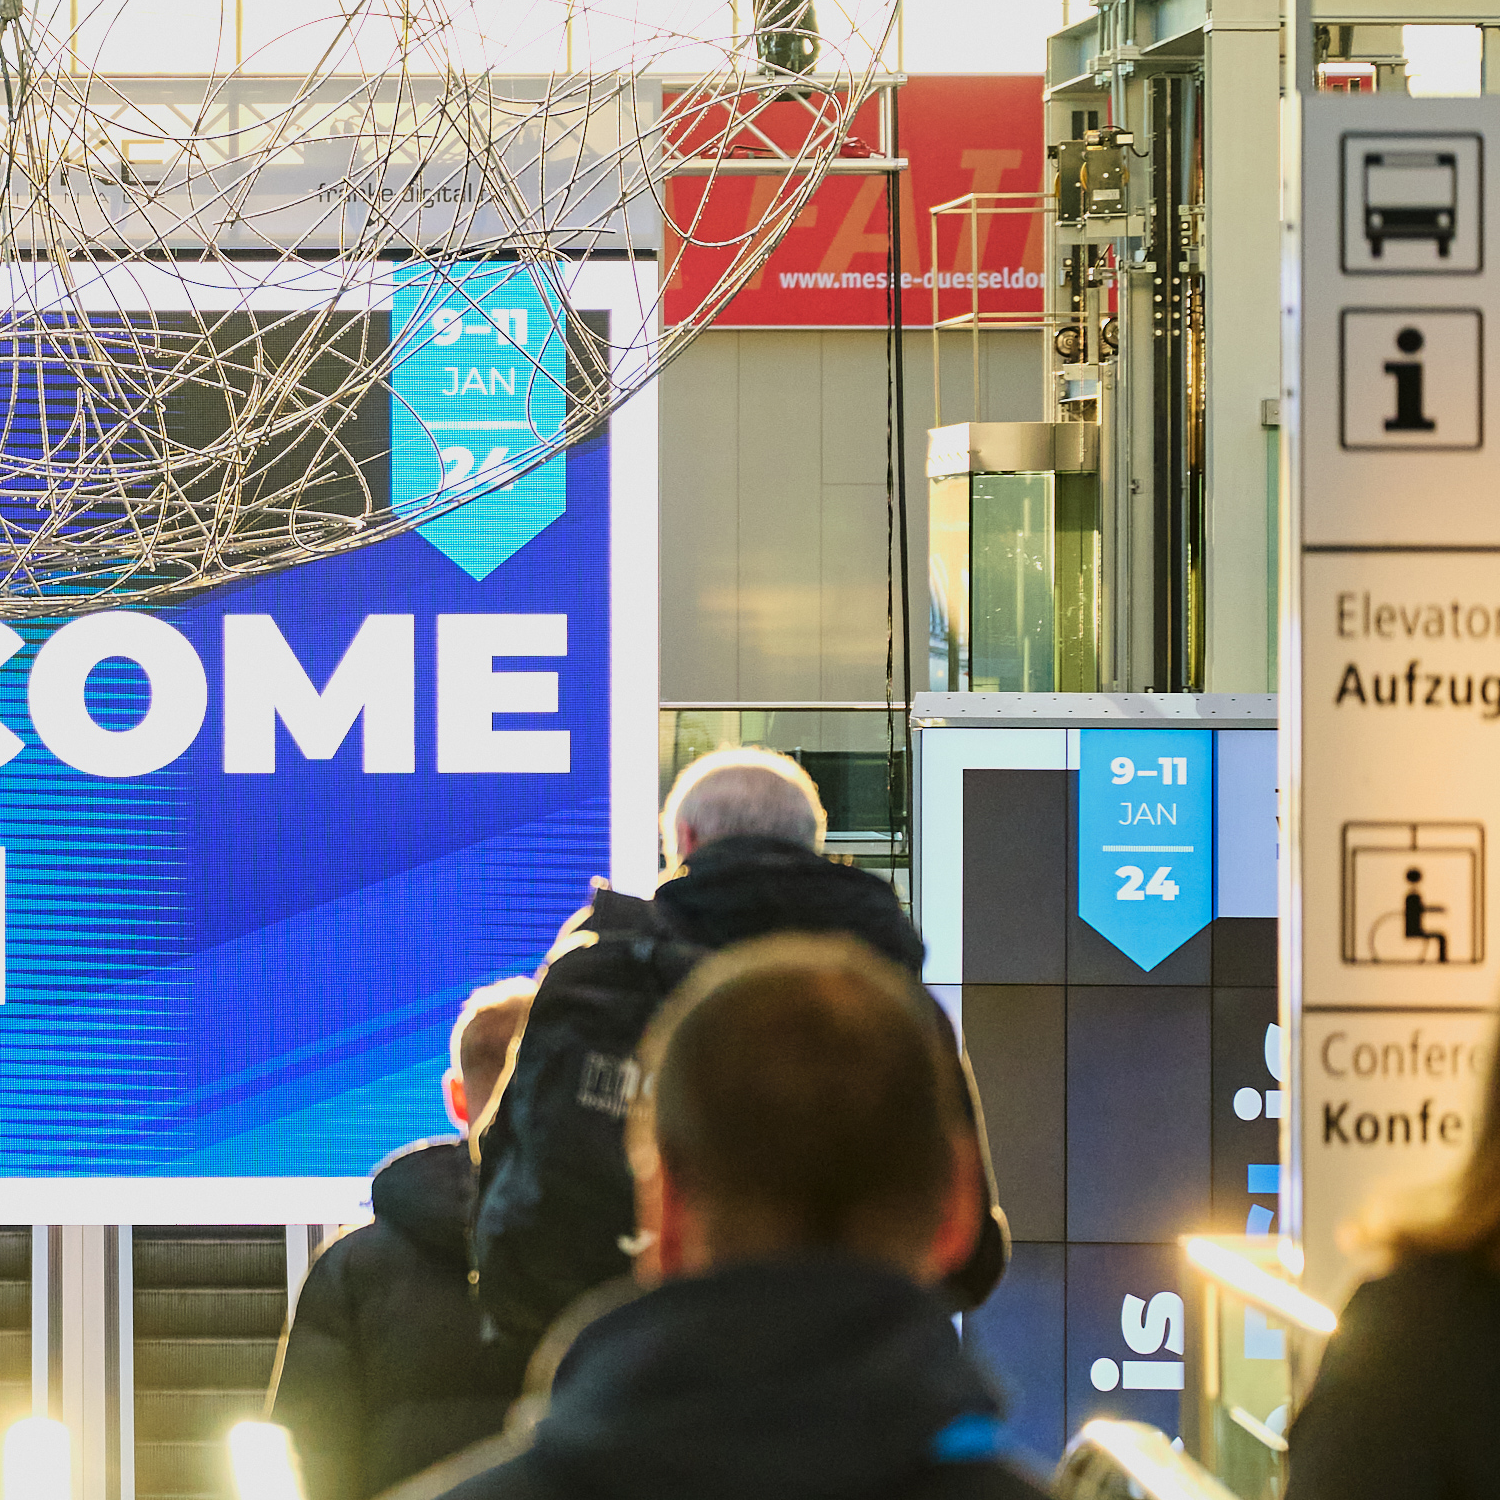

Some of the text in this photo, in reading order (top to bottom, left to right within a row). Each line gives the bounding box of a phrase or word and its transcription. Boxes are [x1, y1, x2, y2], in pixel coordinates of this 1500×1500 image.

[443, 367, 515, 396] JAN
[440, 446, 519, 492] 24
[1335, 659, 1500, 724] Aufzug
[1118, 802, 1177, 826] JAN
[1114, 865, 1180, 901] 24
